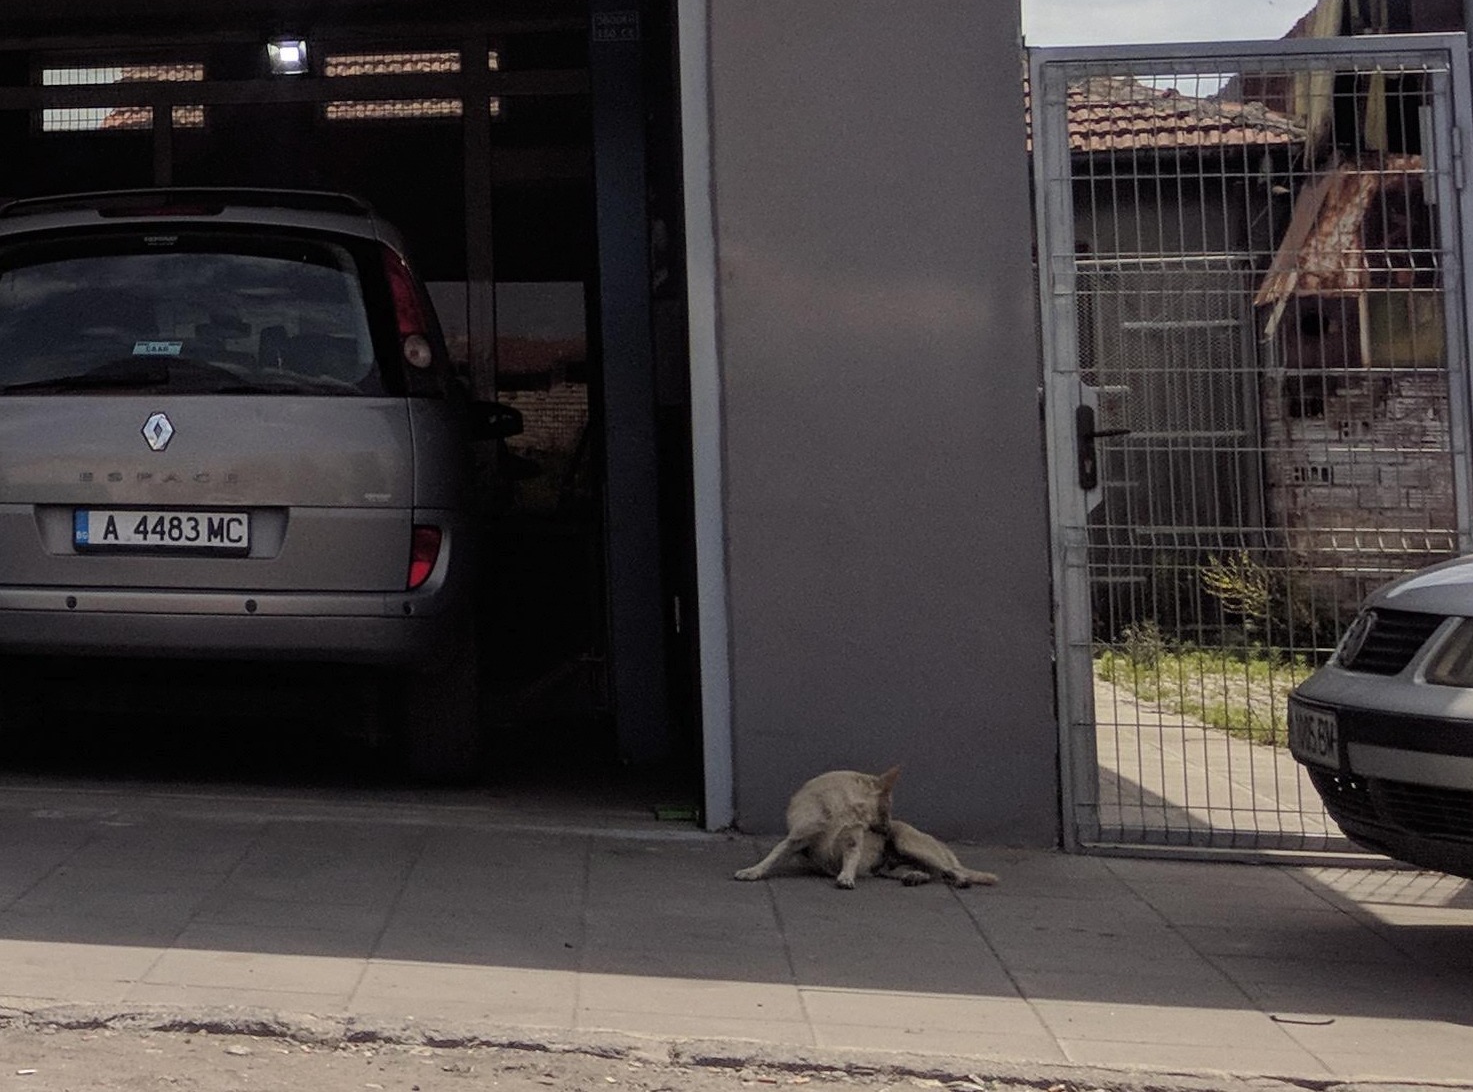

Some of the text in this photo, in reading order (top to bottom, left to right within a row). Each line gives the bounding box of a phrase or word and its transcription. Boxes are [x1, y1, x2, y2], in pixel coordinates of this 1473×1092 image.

[79, 471, 238, 483] ESPACE
[103, 514, 243, 543] A 4483 MC
